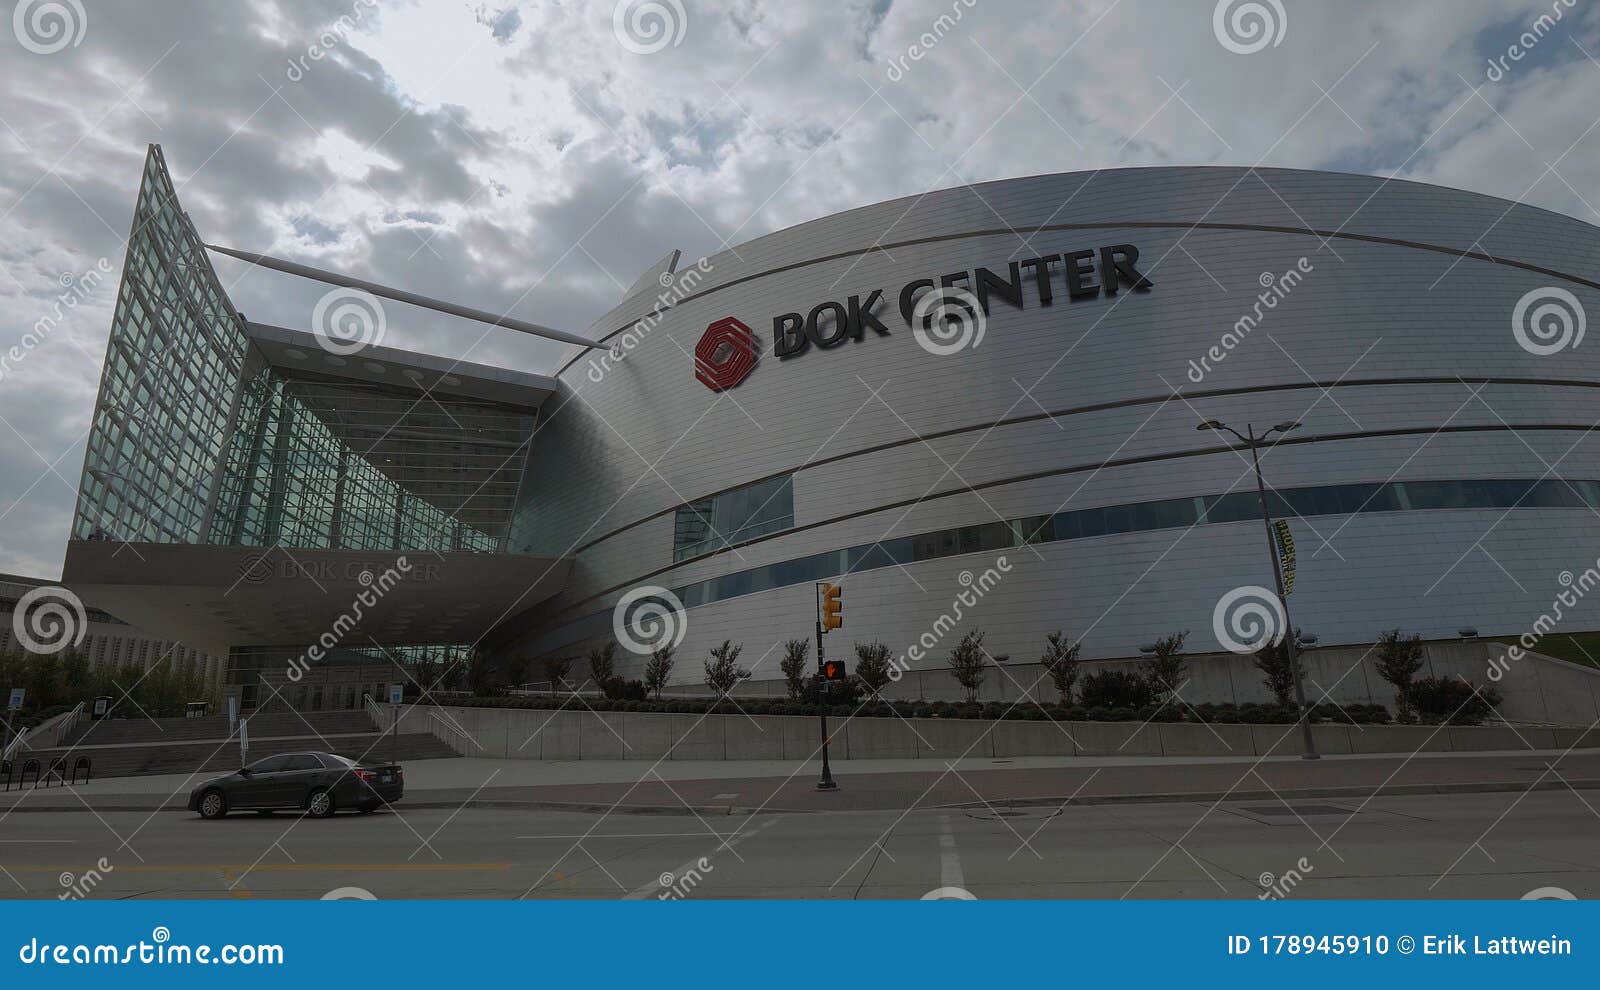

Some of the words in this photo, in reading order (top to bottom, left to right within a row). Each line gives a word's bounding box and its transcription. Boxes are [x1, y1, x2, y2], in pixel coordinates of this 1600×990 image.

[773, 288, 889, 357] BOK
[897, 243, 1154, 329] CENTER
[280, 559, 337, 579] BOK
